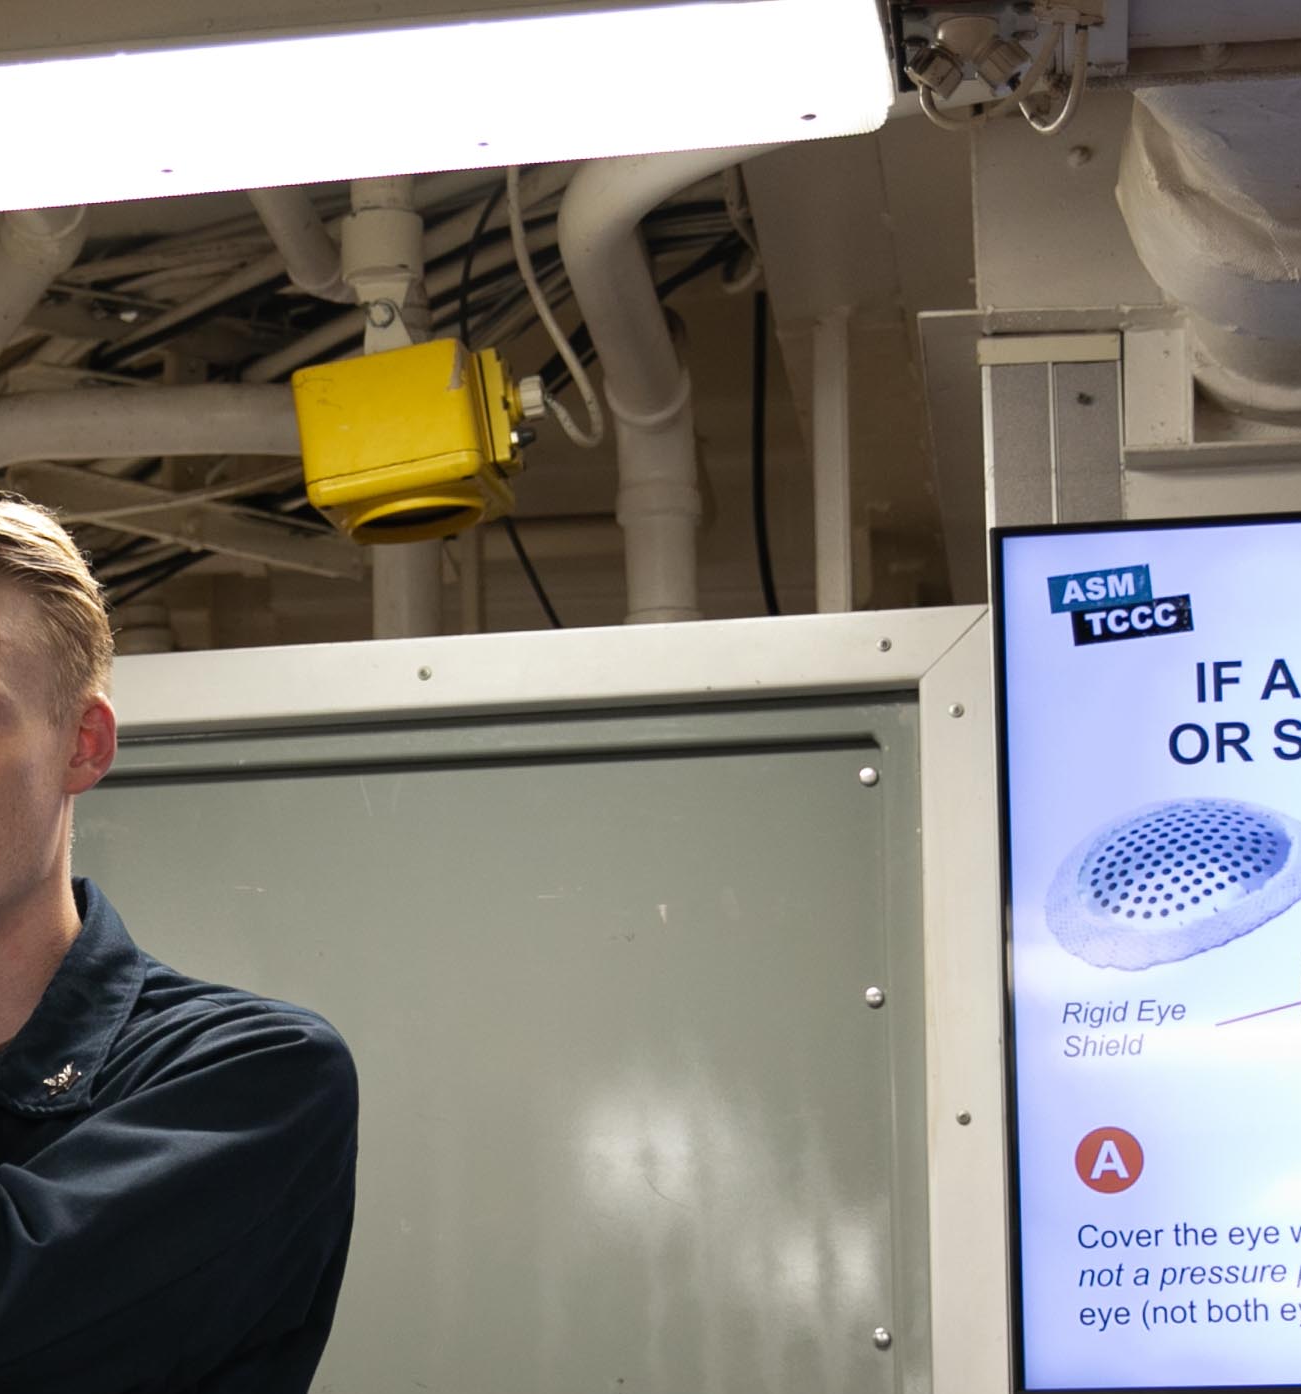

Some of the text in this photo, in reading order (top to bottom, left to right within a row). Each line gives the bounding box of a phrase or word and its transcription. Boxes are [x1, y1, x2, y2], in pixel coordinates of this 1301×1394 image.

[1062, 572, 1136, 605] ASM
[1083, 602, 1178, 637] TCCC
[1195, 659, 1244, 704] IF
[1167, 720, 1256, 766] OR
[1061, 998, 1187, 1030] Rigid Eye
[1063, 1033, 1144, 1058] Shield
[1089, 1140, 1130, 1180] A
[1076, 1223, 1166, 1250] Cover
[1171, 1221, 1219, 1248] the
[1227, 1224, 1281, 1252] eye
[1077, 1261, 1126, 1289] not
[1132, 1266, 1151, 1287] a
[1158, 1263, 1288, 1293] pressure
[1078, 1305, 1132, 1333] eye
[1141, 1298, 1199, 1332] (not
[1206, 1296, 1270, 1324] both
